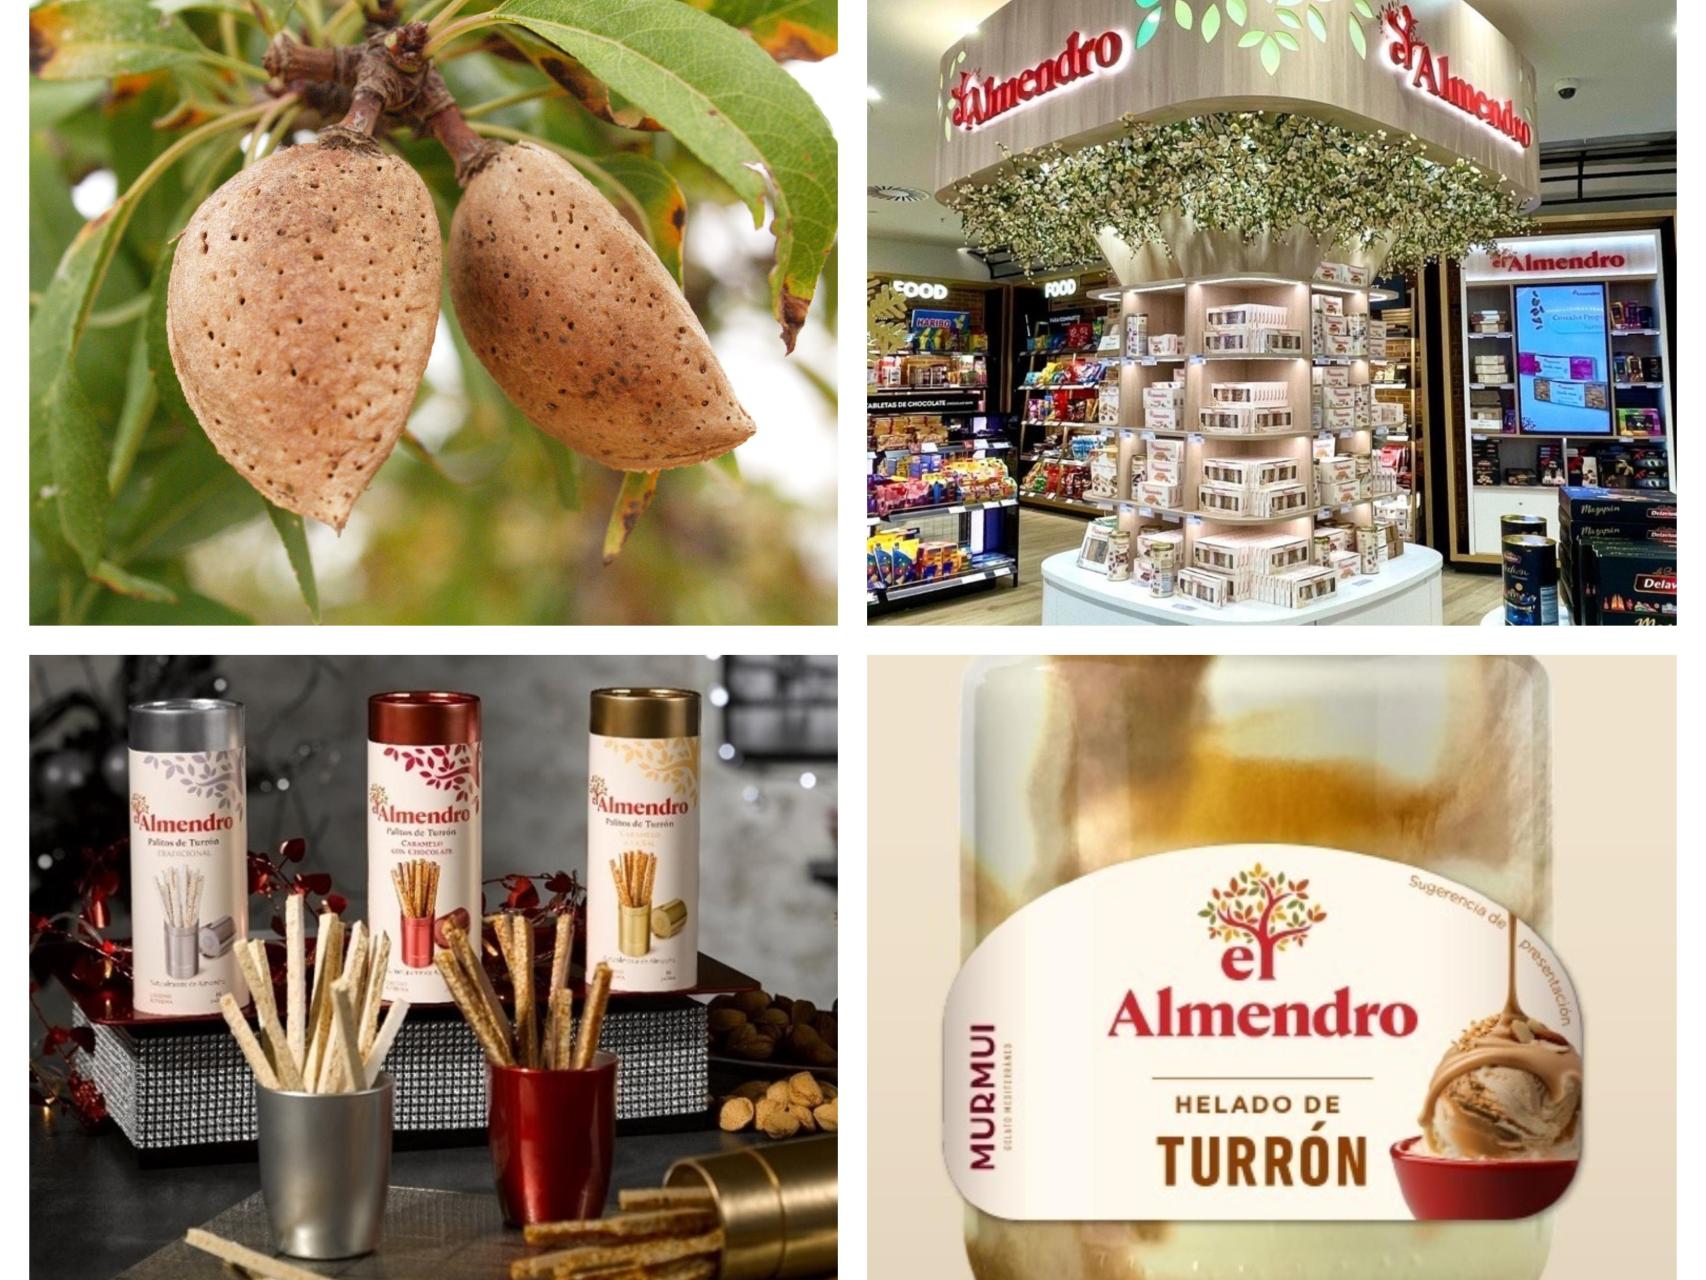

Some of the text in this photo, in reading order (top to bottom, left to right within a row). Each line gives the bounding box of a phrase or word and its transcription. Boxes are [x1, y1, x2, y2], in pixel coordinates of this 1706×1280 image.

[966, 31, 1123, 130] Almendro
[1413, 45, 1531, 148] Almendro
[1508, 250, 1625, 272] Almendro
[893, 280, 948, 300] FOOD
[1045, 278, 1077, 298] FOOD
[916, 317, 951, 329] HARIBO
[377, 805, 470, 824] Almendro
[598, 796, 689, 815] Almendro
[139, 812, 233, 832] Almendro
[414, 827, 425, 837] de
[427, 827, 457, 837] Turrón
[632, 820, 643, 828] de
[645, 819, 674, 828] Turrón
[147, 837, 220, 847] Palitos de Turrón
[400, 840, 443, 848] CARAMELO
[1408, 874, 1571, 1027] Sugerencia de presentación
[1107, 986, 1419, 1038] Almendro
[970, 1025, 995, 1169] MURMUI
[1175, 1095, 1340, 1114] HELADO DE
[1156, 1120, 1367, 1187] TURRÓN
